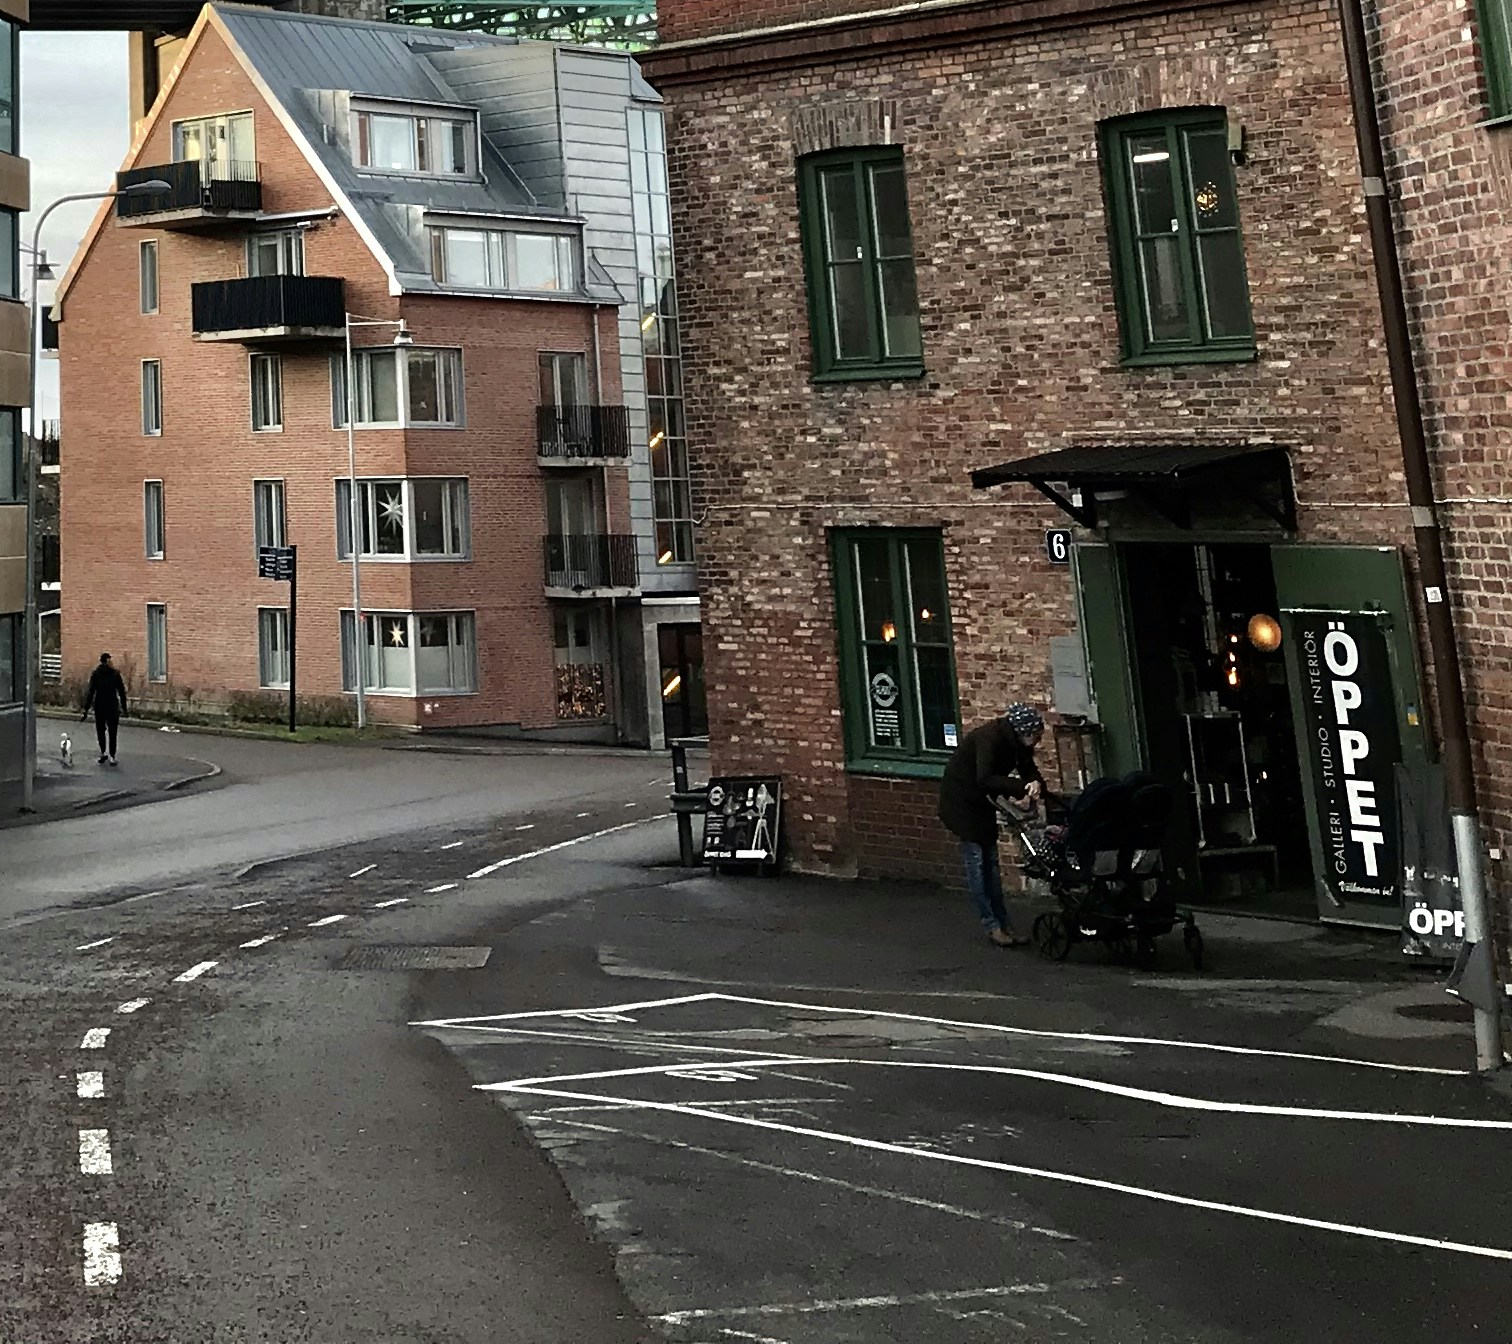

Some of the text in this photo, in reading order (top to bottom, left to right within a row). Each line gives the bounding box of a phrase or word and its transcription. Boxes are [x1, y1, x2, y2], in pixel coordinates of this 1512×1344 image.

[1053, 533, 1065, 559] 6
[1304, 631, 1347, 874] GALLERI STUDIO INTERIÖR
[1324, 621, 1384, 877] ÖPPET
